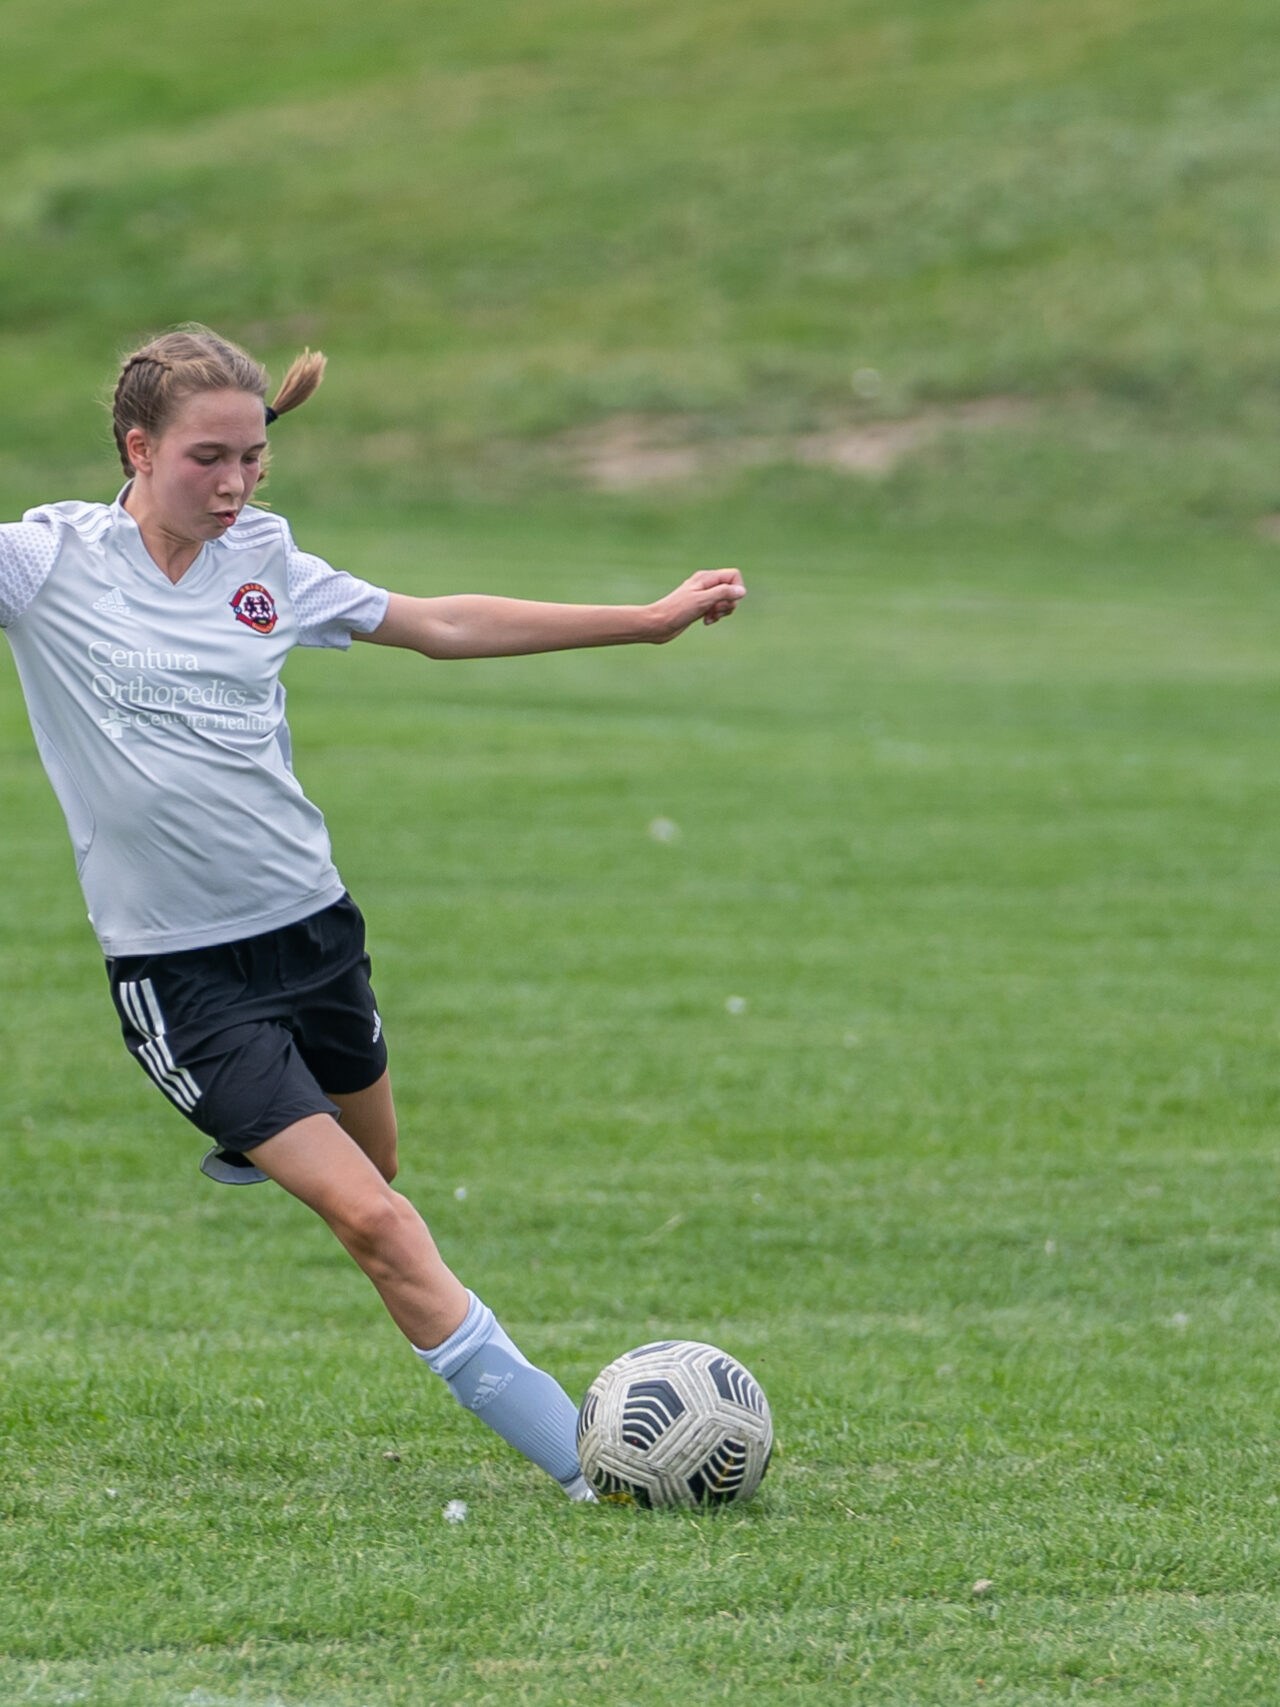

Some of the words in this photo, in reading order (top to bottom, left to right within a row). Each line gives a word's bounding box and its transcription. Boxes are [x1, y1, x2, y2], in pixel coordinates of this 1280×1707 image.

[88, 641, 200, 671] Centura
[92, 674, 247, 710] Orthopedics
[213, 713, 268, 731] Health
